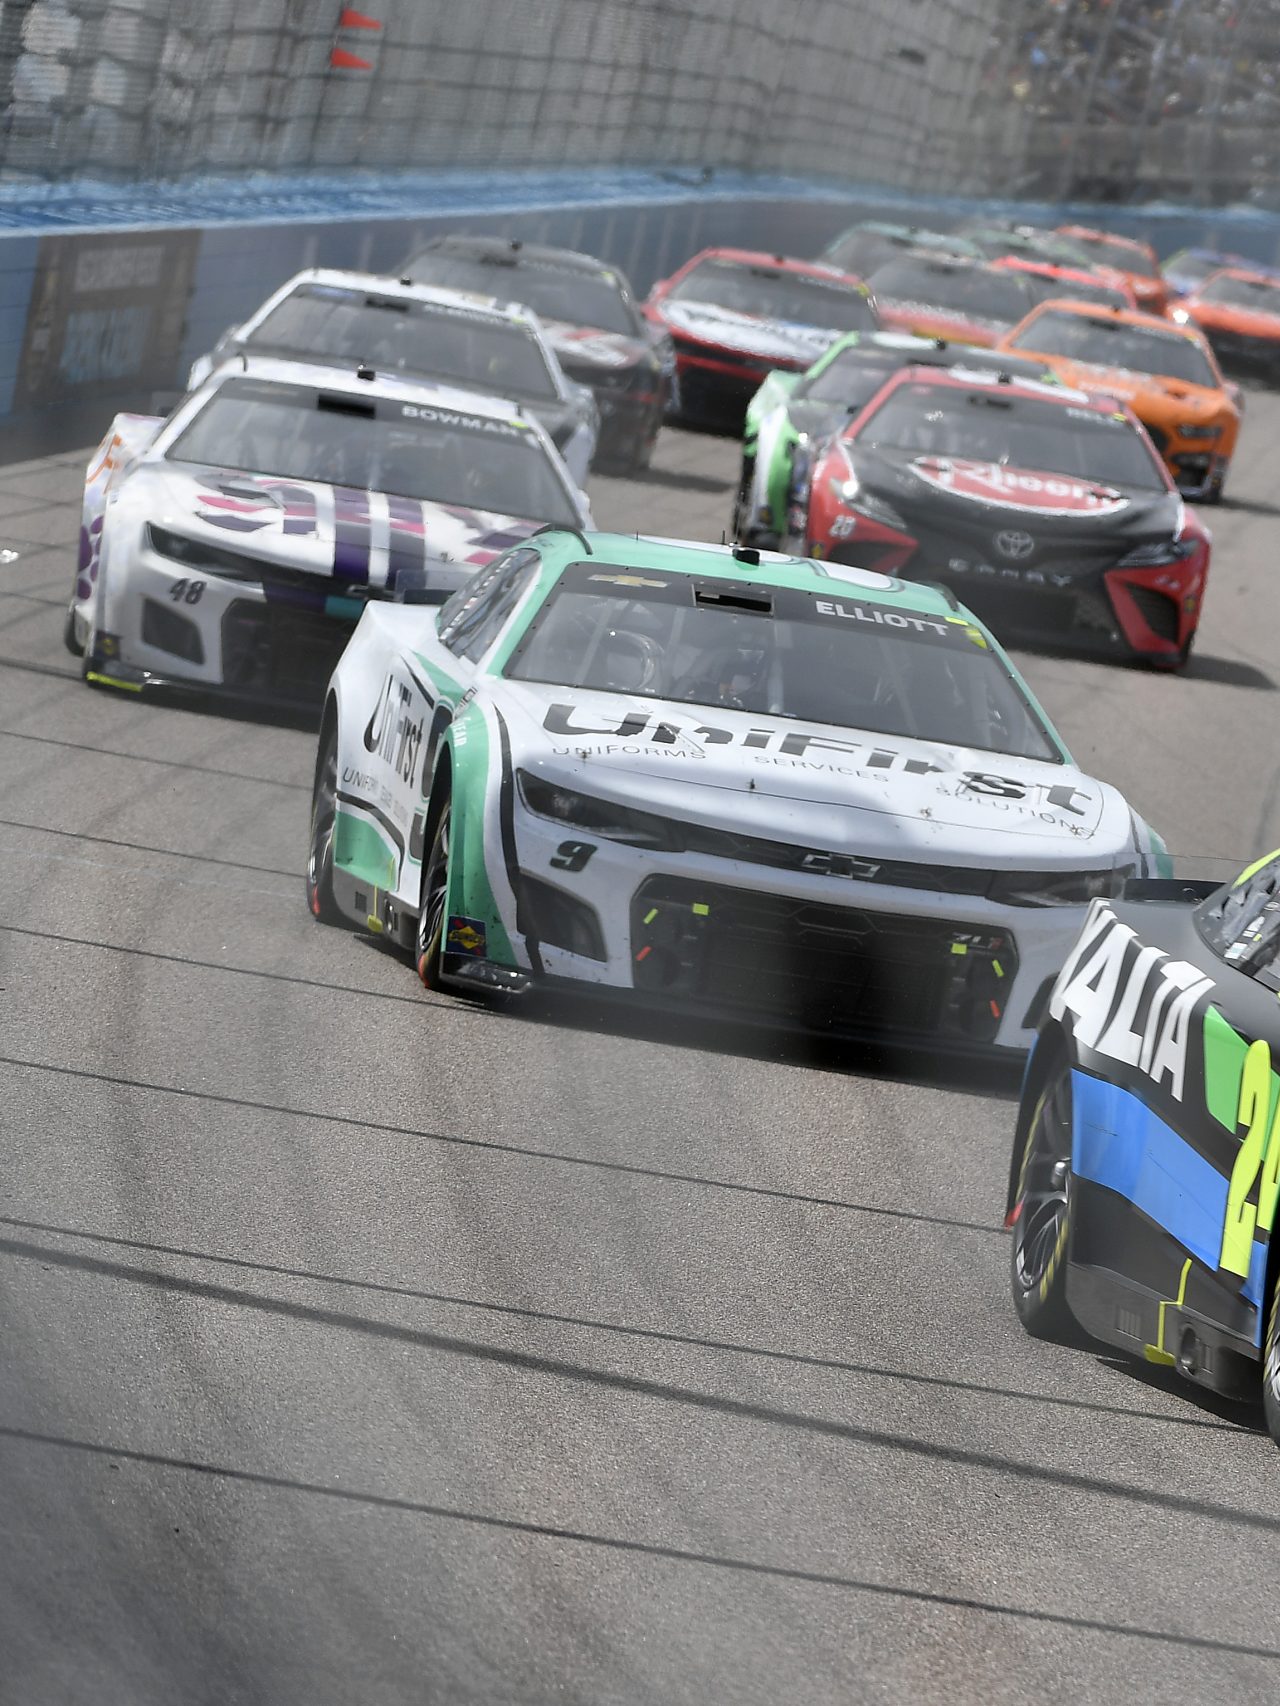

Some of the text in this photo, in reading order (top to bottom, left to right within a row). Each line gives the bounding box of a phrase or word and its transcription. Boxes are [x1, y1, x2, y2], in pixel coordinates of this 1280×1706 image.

[402, 405, 520, 437] BOWMAN
[169, 578, 208, 605] 48
[815, 600, 950, 636] ELLIOTT
[551, 744, 708, 761] UNIFORMS
[753, 755, 889, 784] SERVICES
[549, 840, 597, 872] 9
